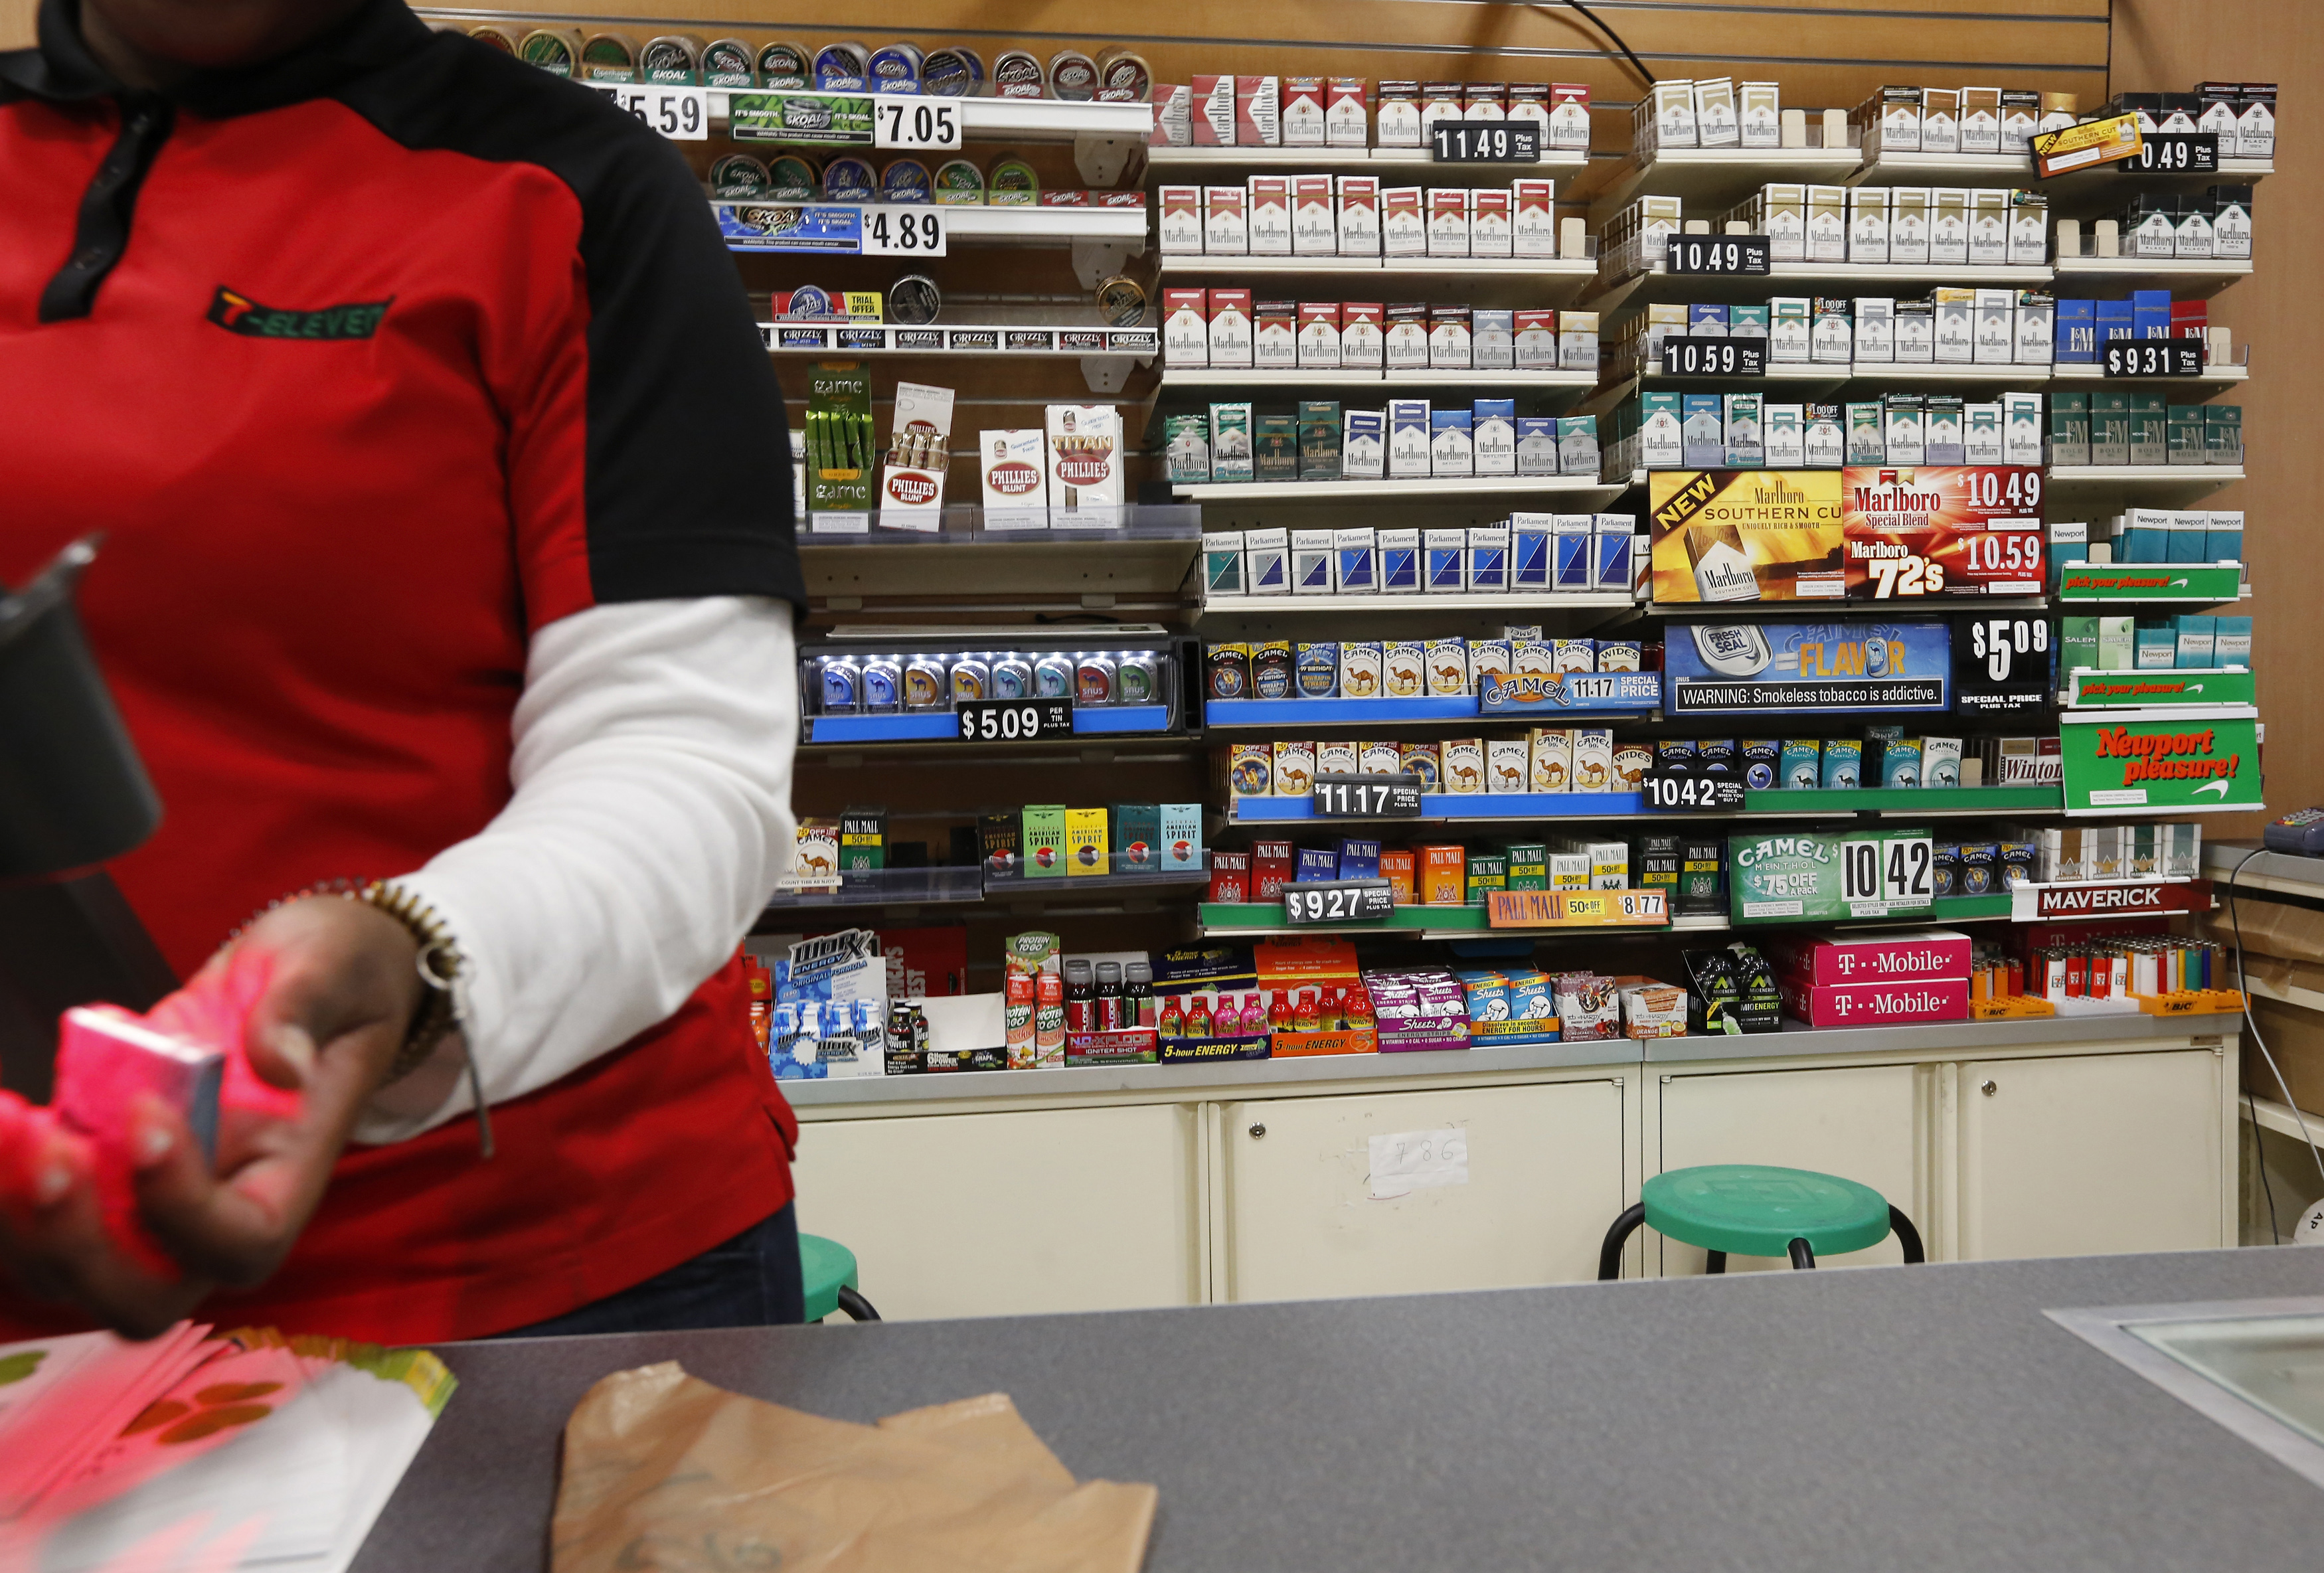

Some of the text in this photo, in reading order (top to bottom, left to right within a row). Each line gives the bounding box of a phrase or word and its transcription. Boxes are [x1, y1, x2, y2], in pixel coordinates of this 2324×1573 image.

[652, 70, 687, 80] SKOAL
[786, 114, 822, 125] SKOAL
[878, 105, 955, 143] $7.05
[1286, 121, 1325, 136] Marlboro
[2240, 121, 2273, 139] Marlboro
[1434, 129, 1507, 158] $11.49
[865, 213, 940, 250] $4.89
[1854, 230, 1885, 247] Marlboro
[2217, 222, 2250, 240] Marlboro
[1669, 243, 1738, 270] $10.49
[851, 295, 874, 304] TRIAL
[784, 330, 821, 340] GRIZZLY
[2070, 326, 2094, 352] L&M
[1665, 345, 1734, 372] $10.59
[2110, 347, 2169, 374] $9.31
[1052, 436, 1114, 450] TITAN
[1394, 444, 1428, 460] Marlboro
[1061, 462, 1107, 478] PHILLIES
[892, 478, 935, 495] PHILLIES
[1755, 481, 1804, 505] Marlboro
[1957, 472, 2040, 507] $10.49
[900, 493, 924, 503] BLUNT
[1656, 473, 1716, 531] NEW
[1854, 487, 1940, 512] Marlboro
[1705, 507, 1842, 519] SOUTHERN CU
[1866, 514, 1929, 529] Special Blend
[1517, 517, 1550, 528] Parliament
[2054, 530, 2085, 538] Newport
[1851, 542, 1908, 558] Marlboro
[1957, 536, 2040, 570] $10.59
[1705, 563, 1754, 590] Marlboro
[1868, 555, 1944, 598] 72's
[2065, 576, 2171, 590] pick your pleasure!
[2183, 638, 2212, 647] Newport
[1386, 649, 1422, 660] CAMEL
[1602, 649, 1639, 660] WIDES
[1800, 641, 1906, 677] FLAVR
[1570, 677, 1614, 697] $11.17
[1620, 676, 1658, 685] SPECIAL
[2082, 682, 2185, 697] pick your pleasure!
[1485, 677, 1571, 706] CAMEL
[1620, 686, 1658, 697] PRICE
[1683, 685, 1938, 705] WARNING: Smokeless tobacco is addictive.
[963, 707, 1038, 740] $5.09
[2096, 726, 2214, 761] Newport
[2122, 754, 2240, 786] pleasure!
[1315, 784, 1389, 813] $11.17
[1643, 778, 1715, 805] $10.42
[1512, 850, 1542, 863] PALL MALL
[1737, 838, 1830, 867] CAMEL
[1755, 862, 1817, 870] MENTHOL
[1888, 843, 1930, 895] 42
[1788, 872, 1817, 886] OFF
[1289, 889, 1362, 920] $9.27
[1497, 895, 1564, 920] PALL MALL
[1569, 899, 1600, 912] 50¢ OFF
[1618, 896, 1661, 914] $8.77
[2042, 887, 2161, 910] MAVERICK
[1399, 1019, 1436, 1031] Sheets
[1165, 1044, 1237, 1057] 5-hour ENERGY
